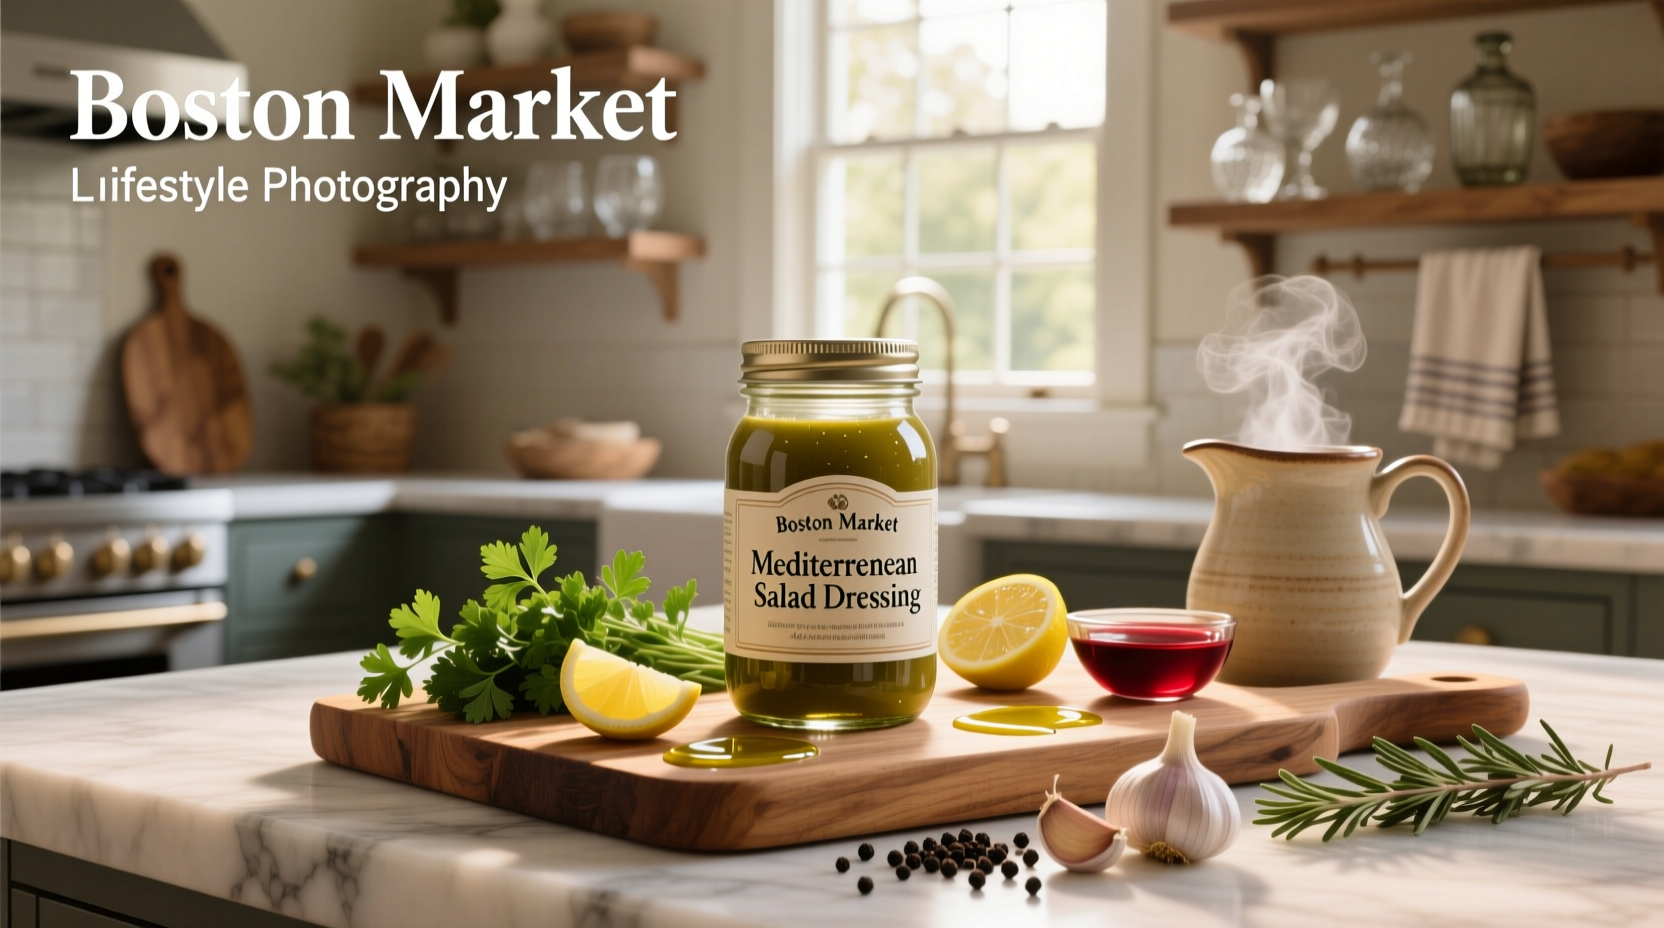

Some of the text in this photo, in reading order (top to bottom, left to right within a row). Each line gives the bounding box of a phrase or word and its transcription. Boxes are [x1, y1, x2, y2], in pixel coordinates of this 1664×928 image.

[776, 511, 899, 534] Boston Market
[751, 549, 918, 577] Mediterrenean
[754, 581, 922, 615] Salad Dressing
